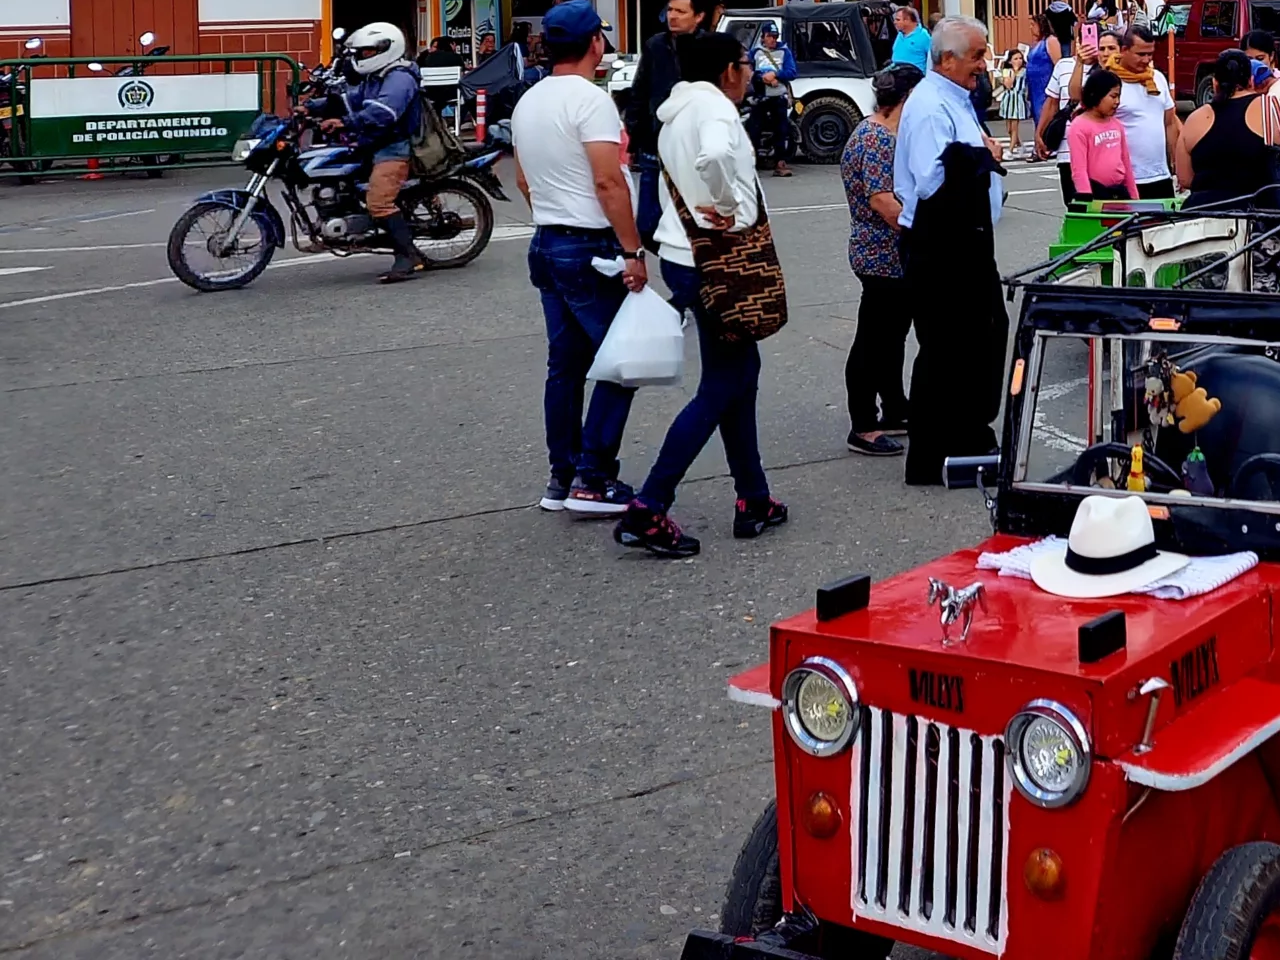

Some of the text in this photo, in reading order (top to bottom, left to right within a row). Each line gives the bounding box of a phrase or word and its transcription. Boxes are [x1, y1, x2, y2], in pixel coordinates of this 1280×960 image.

[447, 26, 472, 38] Colada
[461, 42, 470, 54] la
[86, 116, 212, 131] DEPARTAMENTO
[72, 127, 228, 142] DE POLICÍA QUINDÍO
